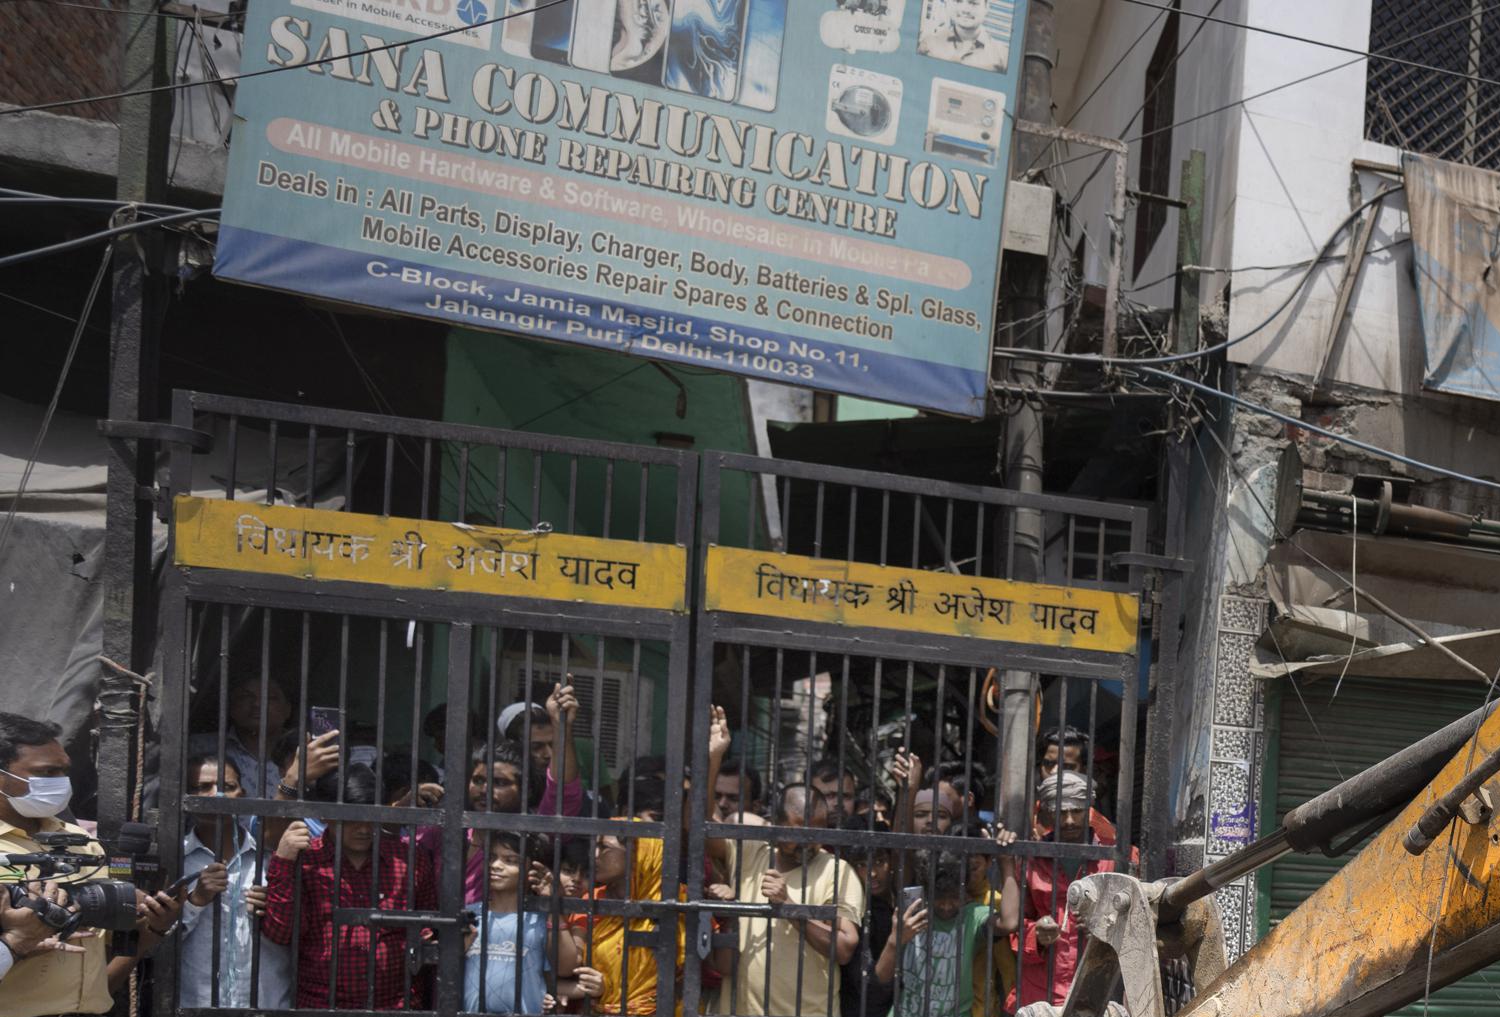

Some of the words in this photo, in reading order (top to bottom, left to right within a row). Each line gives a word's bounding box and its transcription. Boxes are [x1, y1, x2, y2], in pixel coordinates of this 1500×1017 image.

[266, 16, 450, 102] SANA
[472, 63, 988, 220] COMMUNICATION
[286, 123, 321, 150] All
[329, 132, 411, 170] Mobile
[417, 152, 532, 195] Hardware
[538, 176, 556, 200] &
[371, 99, 402, 133] &
[413, 106, 547, 165] PHONE
[558, 138, 757, 208] REPAIRING
[764, 184, 898, 238] CENTRE
[257, 160, 329, 198] Deals
[335, 177, 359, 205] in
[378, 188, 414, 216] All
[419, 194, 487, 233] Parts,
[494, 209, 583, 253] Display,
[590, 230, 682, 272] Charger,
[689, 251, 749, 286] Body,
[756, 264, 849, 303] Batteries
[855, 284, 870, 307] &
[876, 289, 914, 317] Spl.
[920, 296, 982, 333] Glass,
[361, 215, 442, 253] Mobile
[446, 233, 589, 282] Accessories
[596, 262, 668, 296] Repair
[673, 278, 748, 314] Spares
[754, 294, 769, 317] &
[776, 298, 894, 342] Connection
[366, 260, 494, 300] C-Block,
[504, 286, 591, 317] Jamia
[601, 304, 700, 341] Masjid,
[709, 325, 780, 355] Shop
[425, 294, 558, 331] Jahangir
[640, 334, 815, 381] Delhi-110033
[236, 513, 376, 565] विधायक
[390, 530, 428, 570] श्री
[557, 554, 641, 590] यादव
[755, 562, 875, 609] विधायक
[885, 579, 919, 616] श्री
[934, 586, 1014, 625] अजेश
[1030, 601, 1100, 635] यादव
